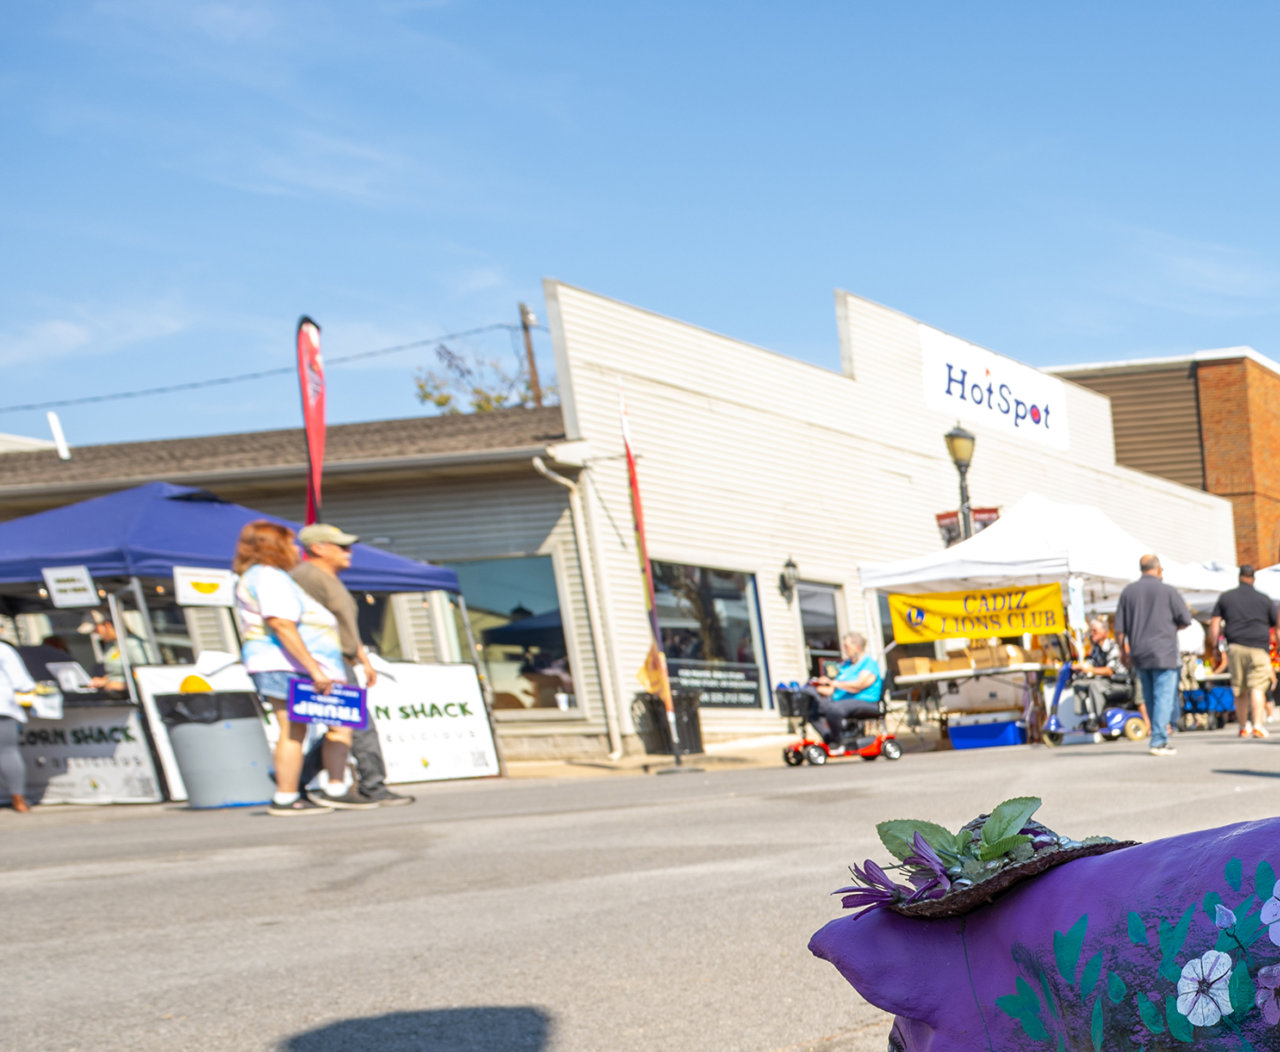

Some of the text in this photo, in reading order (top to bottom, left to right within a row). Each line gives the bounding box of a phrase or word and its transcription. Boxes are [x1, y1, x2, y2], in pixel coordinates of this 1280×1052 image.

[944, 362, 1050, 429] HotSpot
[963, 591, 1028, 614] CADIZ
[941, 610, 1056, 634] LIONS CLUB
[293, 701, 362, 722] TRUMP
[398, 702, 474, 719] SHACK
[69, 726, 137, 745] SHACK
